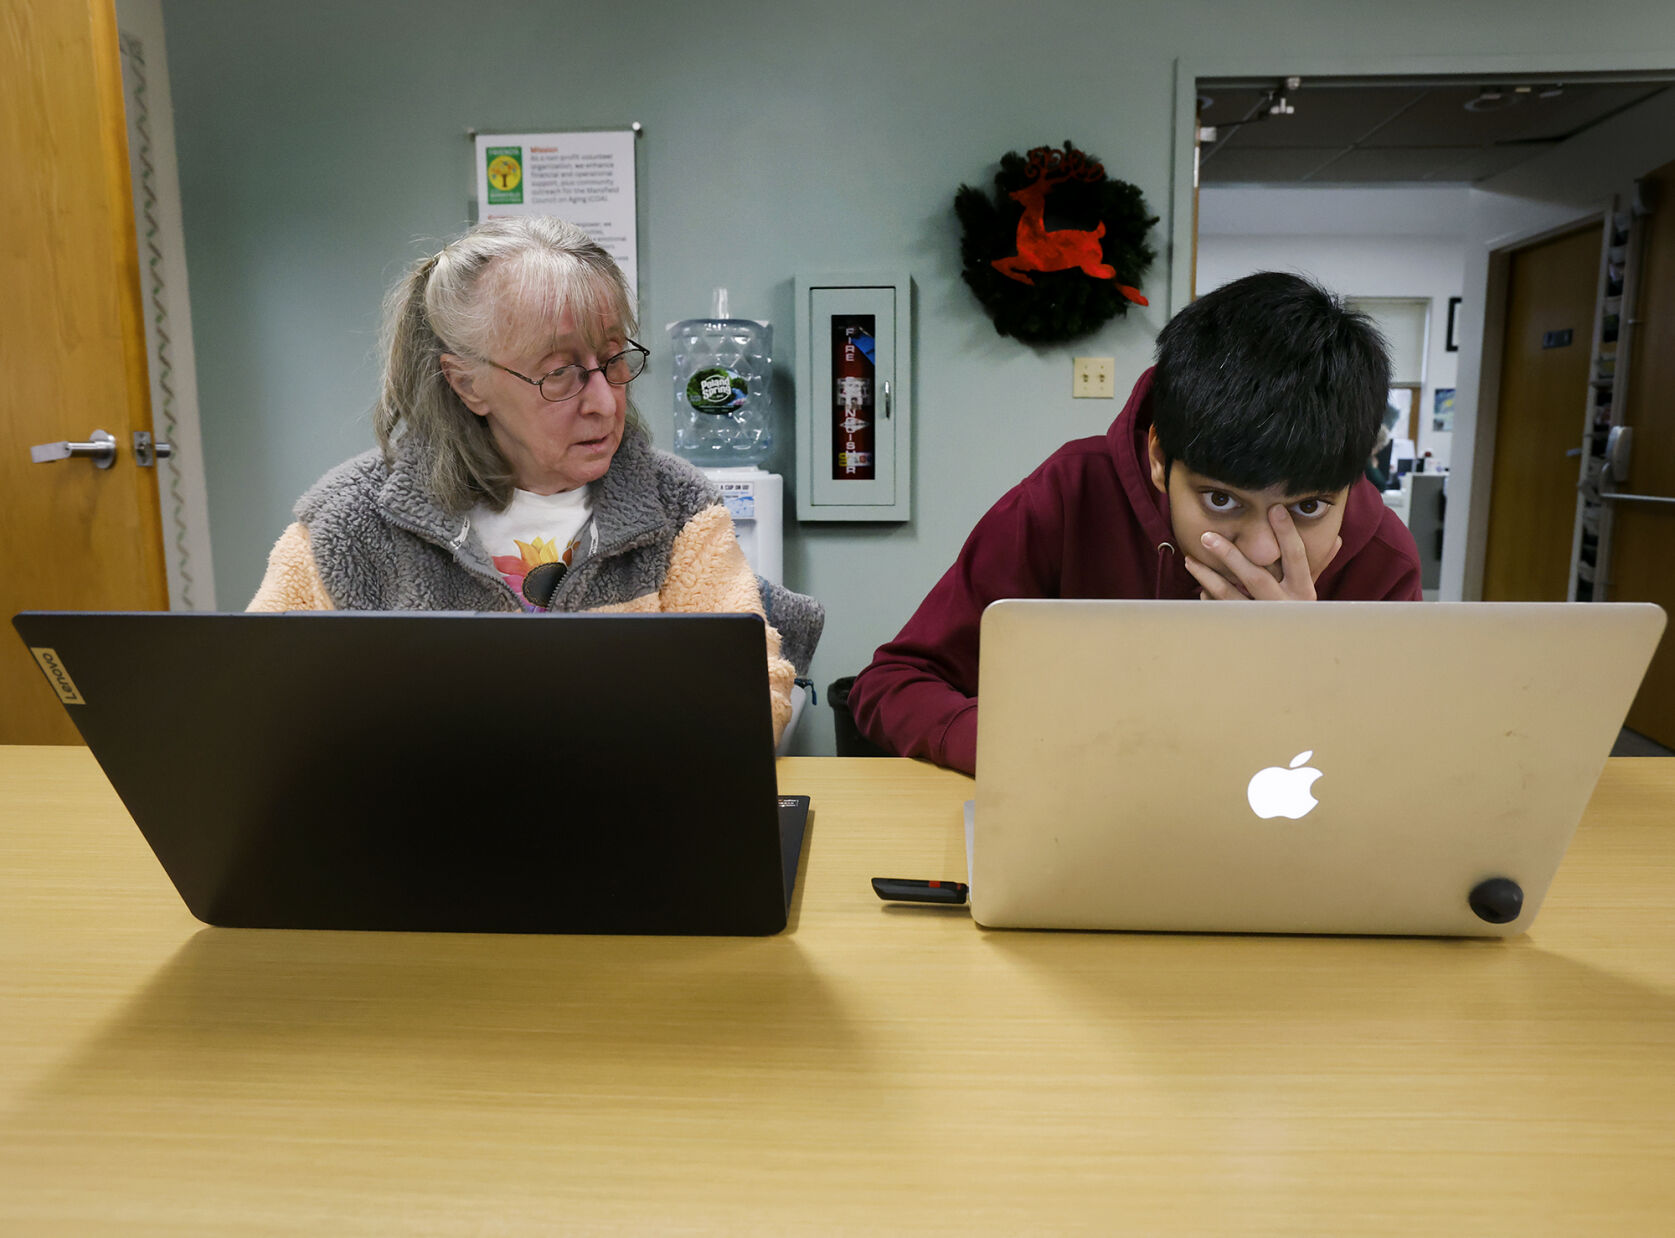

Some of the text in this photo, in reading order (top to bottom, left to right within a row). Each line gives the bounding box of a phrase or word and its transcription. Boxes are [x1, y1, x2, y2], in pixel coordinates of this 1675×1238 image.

[585, 161, 614, 169] enhance
[561, 170, 573, 178] and
[575, 170, 613, 178] operational
[576, 178, 614, 186] community
[531, 187, 561, 195] outreach
[574, 186, 585, 194] the
[586, 185, 620, 194] Mansfield
[569, 195, 587, 204] Aging
[845, 327, 855, 362] FIRE
[701, 376, 730, 390] Poland
[702, 386, 731, 400] Spring
[845, 376, 856, 474] NGUISHR
[43, 653, 77, 699] Lenovo
